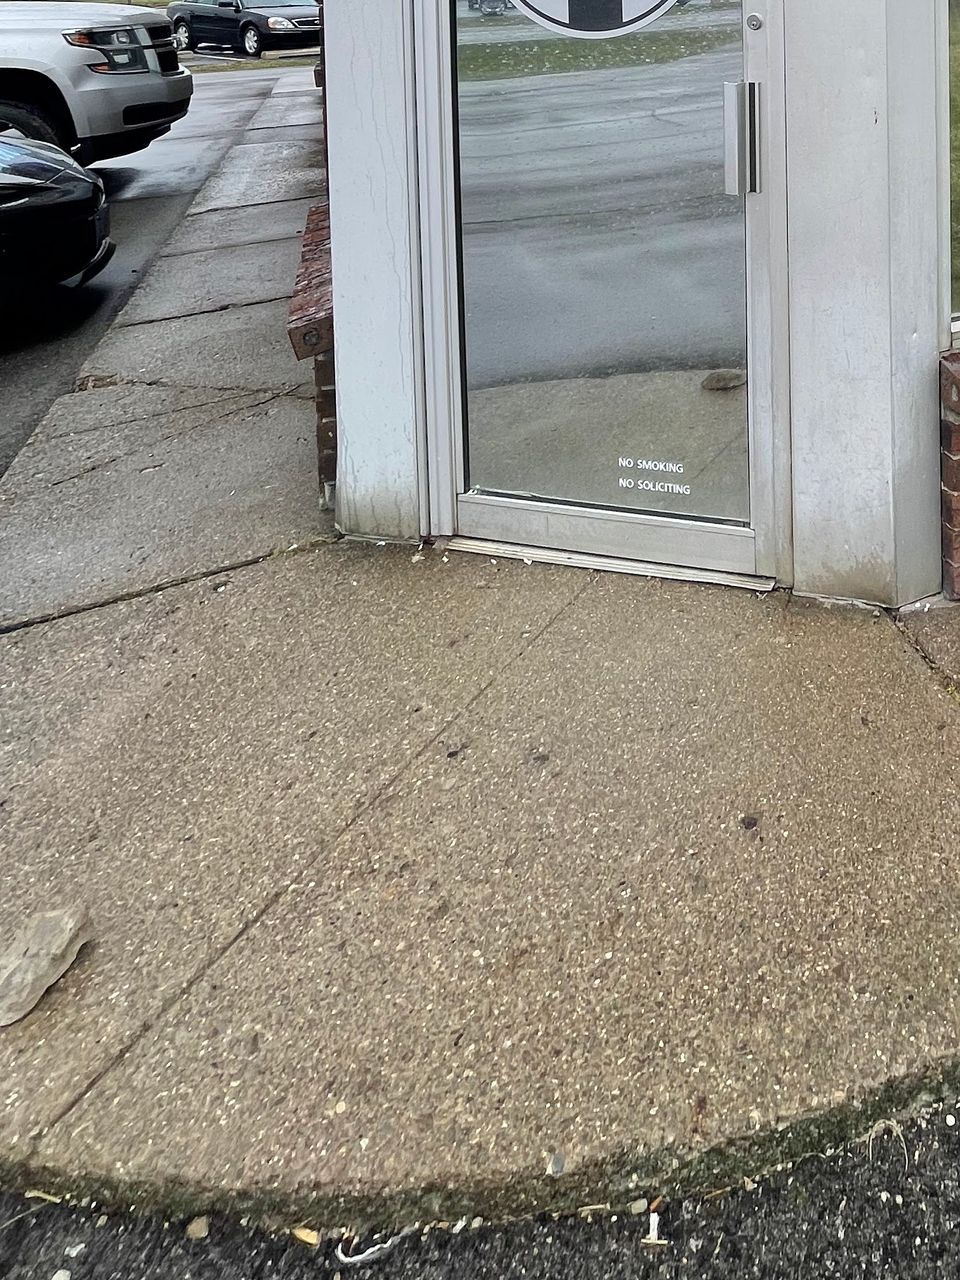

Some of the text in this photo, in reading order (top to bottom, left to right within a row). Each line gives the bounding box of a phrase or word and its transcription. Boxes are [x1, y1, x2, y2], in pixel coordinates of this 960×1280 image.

[618, 457, 684, 473] NO SMOKING
[618, 478, 691, 495] NO SOLICITING
